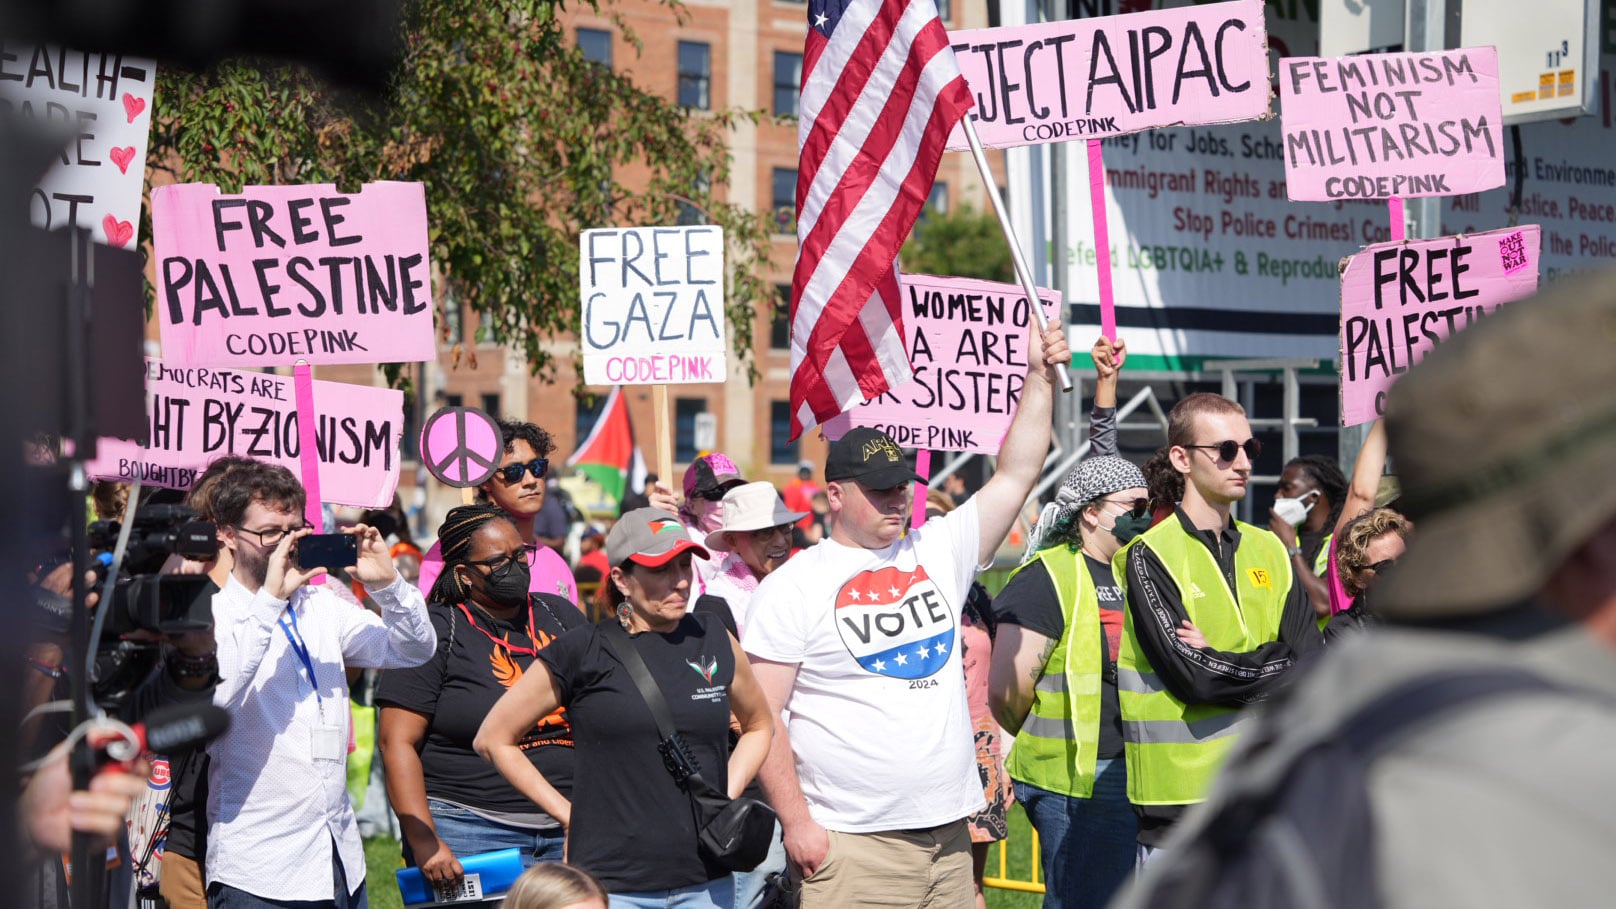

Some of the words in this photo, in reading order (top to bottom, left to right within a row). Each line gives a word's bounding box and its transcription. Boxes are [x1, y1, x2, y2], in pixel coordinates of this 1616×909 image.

[1086, 19, 1250, 115] AIPAC
[1289, 54, 1478, 95] FEMINISM
[1345, 91, 1422, 123] NOT
[1023, 117, 1123, 142] CODEPINK
[1150, 129, 1176, 150] for
[1287, 115, 1496, 168] MILITARISM
[1204, 168, 1260, 203] Rights
[1325, 174, 1451, 198] CODEPINK
[212, 197, 363, 251] FREE
[1173, 207, 1213, 240] Stop
[1221, 210, 1276, 238] Police
[1284, 214, 1355, 243] Crimes!
[1499, 231, 1522, 247] MAKE
[588, 229, 716, 288] FREE
[1128, 245, 1224, 274] LGBTQIA+
[1234, 251, 1249, 275] &
[1500, 238, 1523, 254] OUT
[1502, 246, 1524, 264] NOT
[1374, 246, 1479, 309] FREE
[1504, 255, 1526, 270] WAR
[163, 253, 427, 326] PALESTINE
[585, 289, 720, 350] GAZA
[910, 286, 1004, 325] WOMEN
[226, 329, 368, 356] CODEPINK
[956, 329, 1027, 367] ARE
[606, 354, 713, 382] CODEPINK
[250, 376, 288, 402] ARE
[242, 407, 392, 472] ZIONISM
[1253, 569, 1267, 585] 15
[1095, 585, 1116, 601] REE
[842, 590, 947, 644] VOTE
[909, 679, 939, 690] 2024
[532, 739, 550, 747] and
